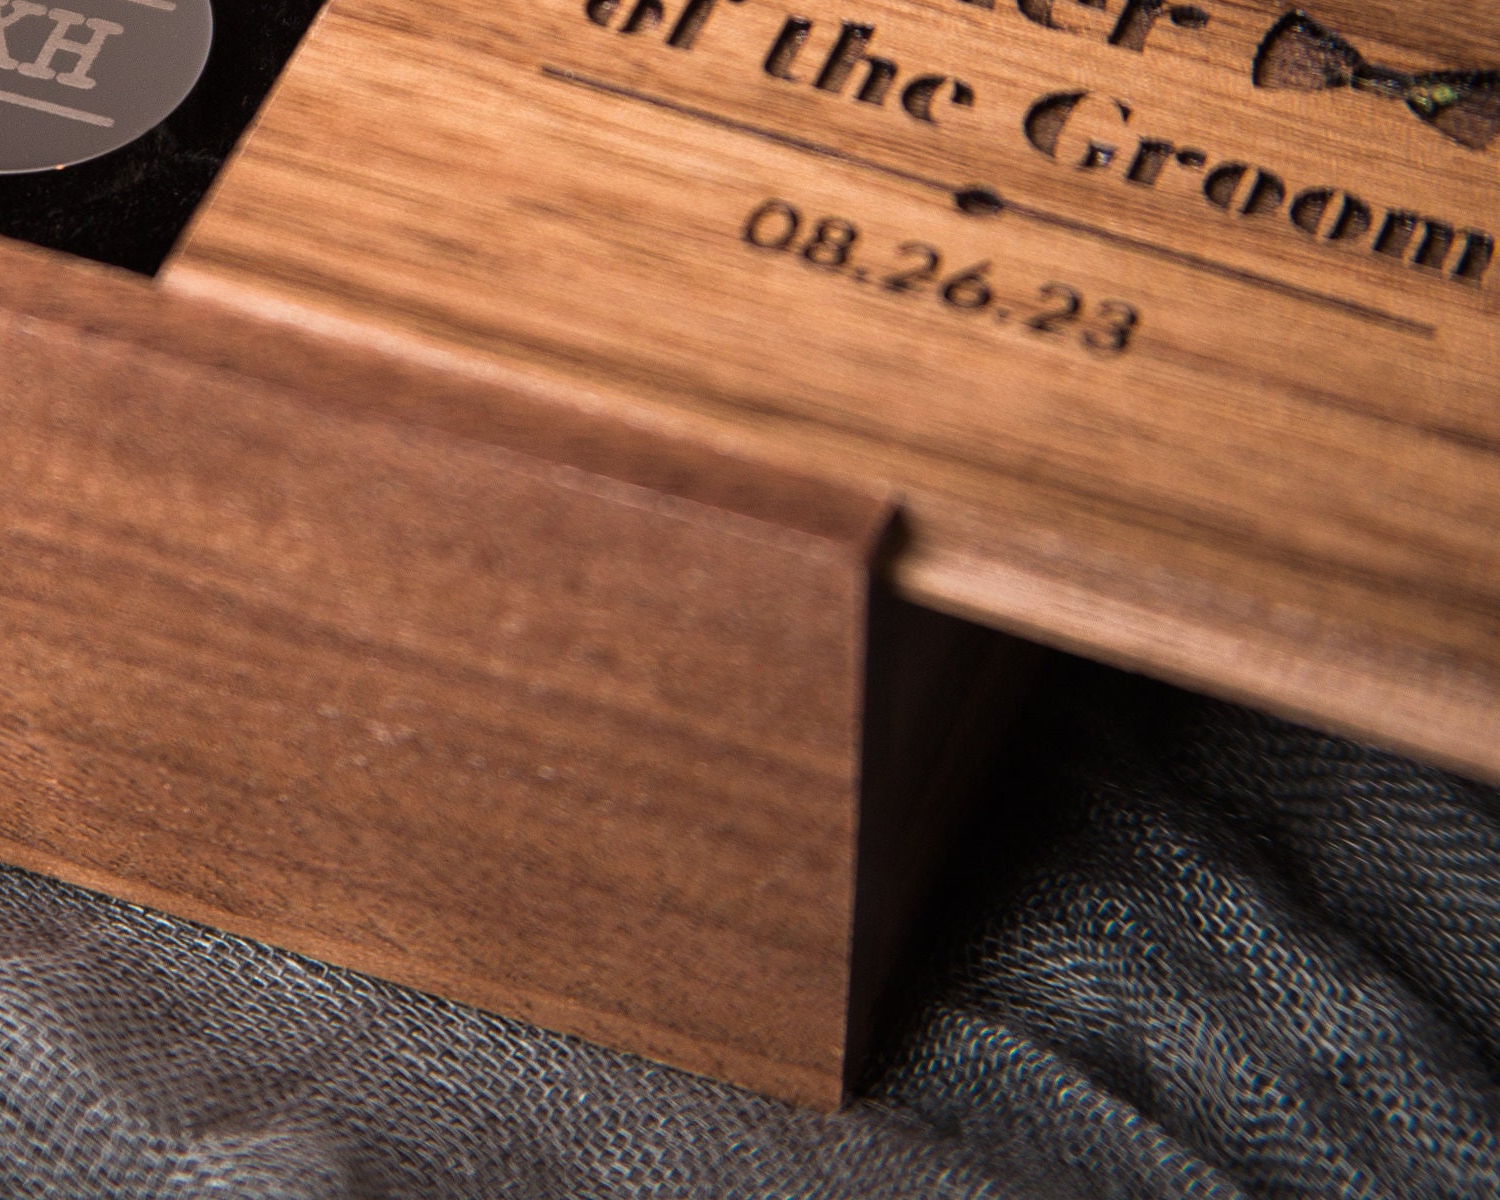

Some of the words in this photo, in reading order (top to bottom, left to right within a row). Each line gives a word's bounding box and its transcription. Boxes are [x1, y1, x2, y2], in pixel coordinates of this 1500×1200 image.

[763, 16, 975, 125] the
[1021, 88, 1496, 282] Groom
[741, 199, 1140, 358] 08.26.23
